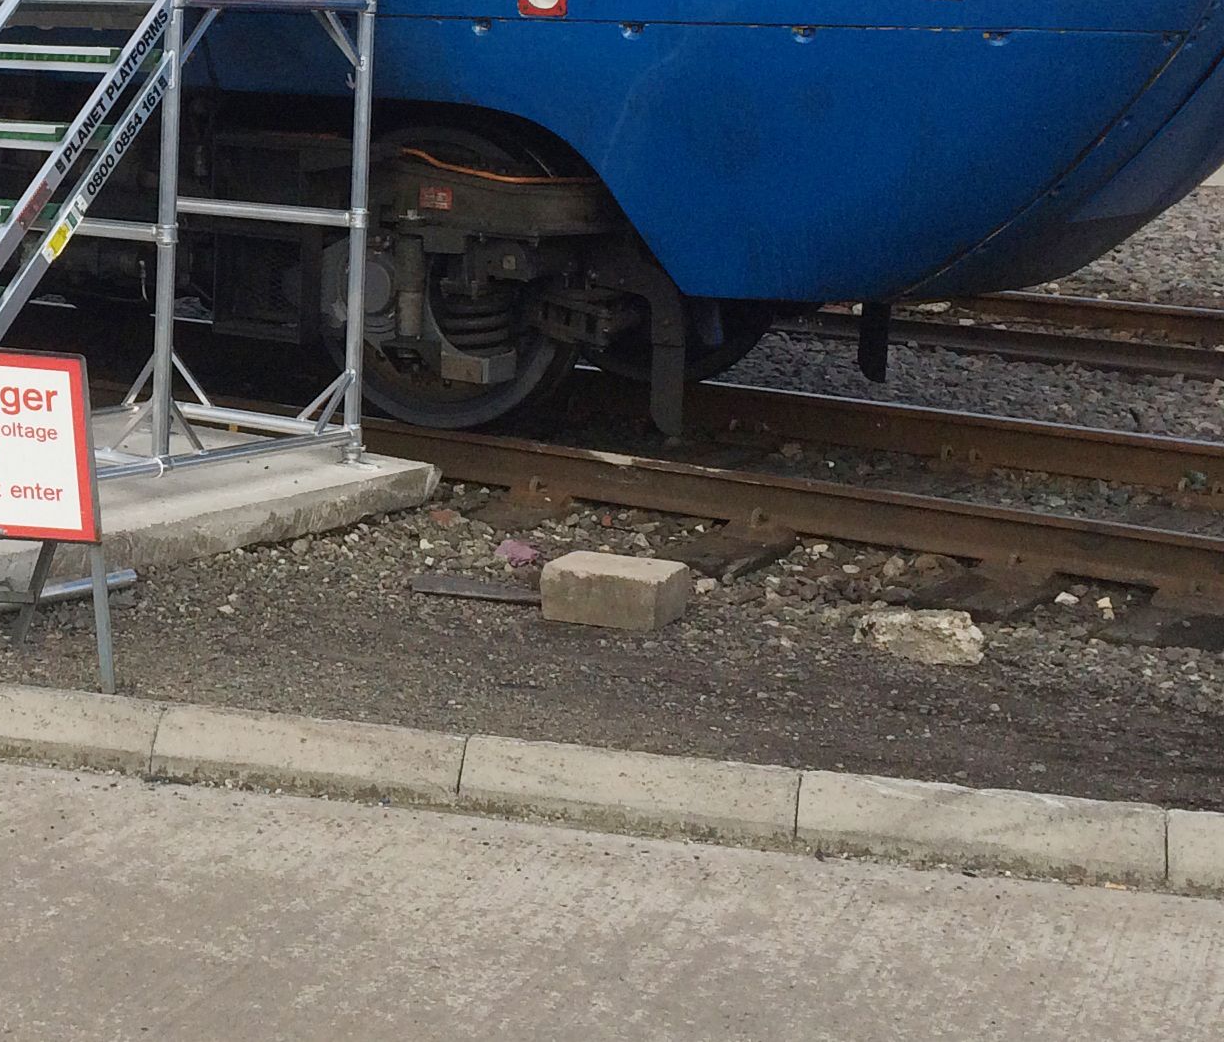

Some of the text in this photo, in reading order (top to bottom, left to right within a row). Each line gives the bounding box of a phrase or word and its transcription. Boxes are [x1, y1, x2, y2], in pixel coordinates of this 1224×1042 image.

[62, 8, 169, 164] PLANET PLATFORMS
[86, 84, 162, 197] 0800 0854 161
[10, 483, 63, 501] enter
